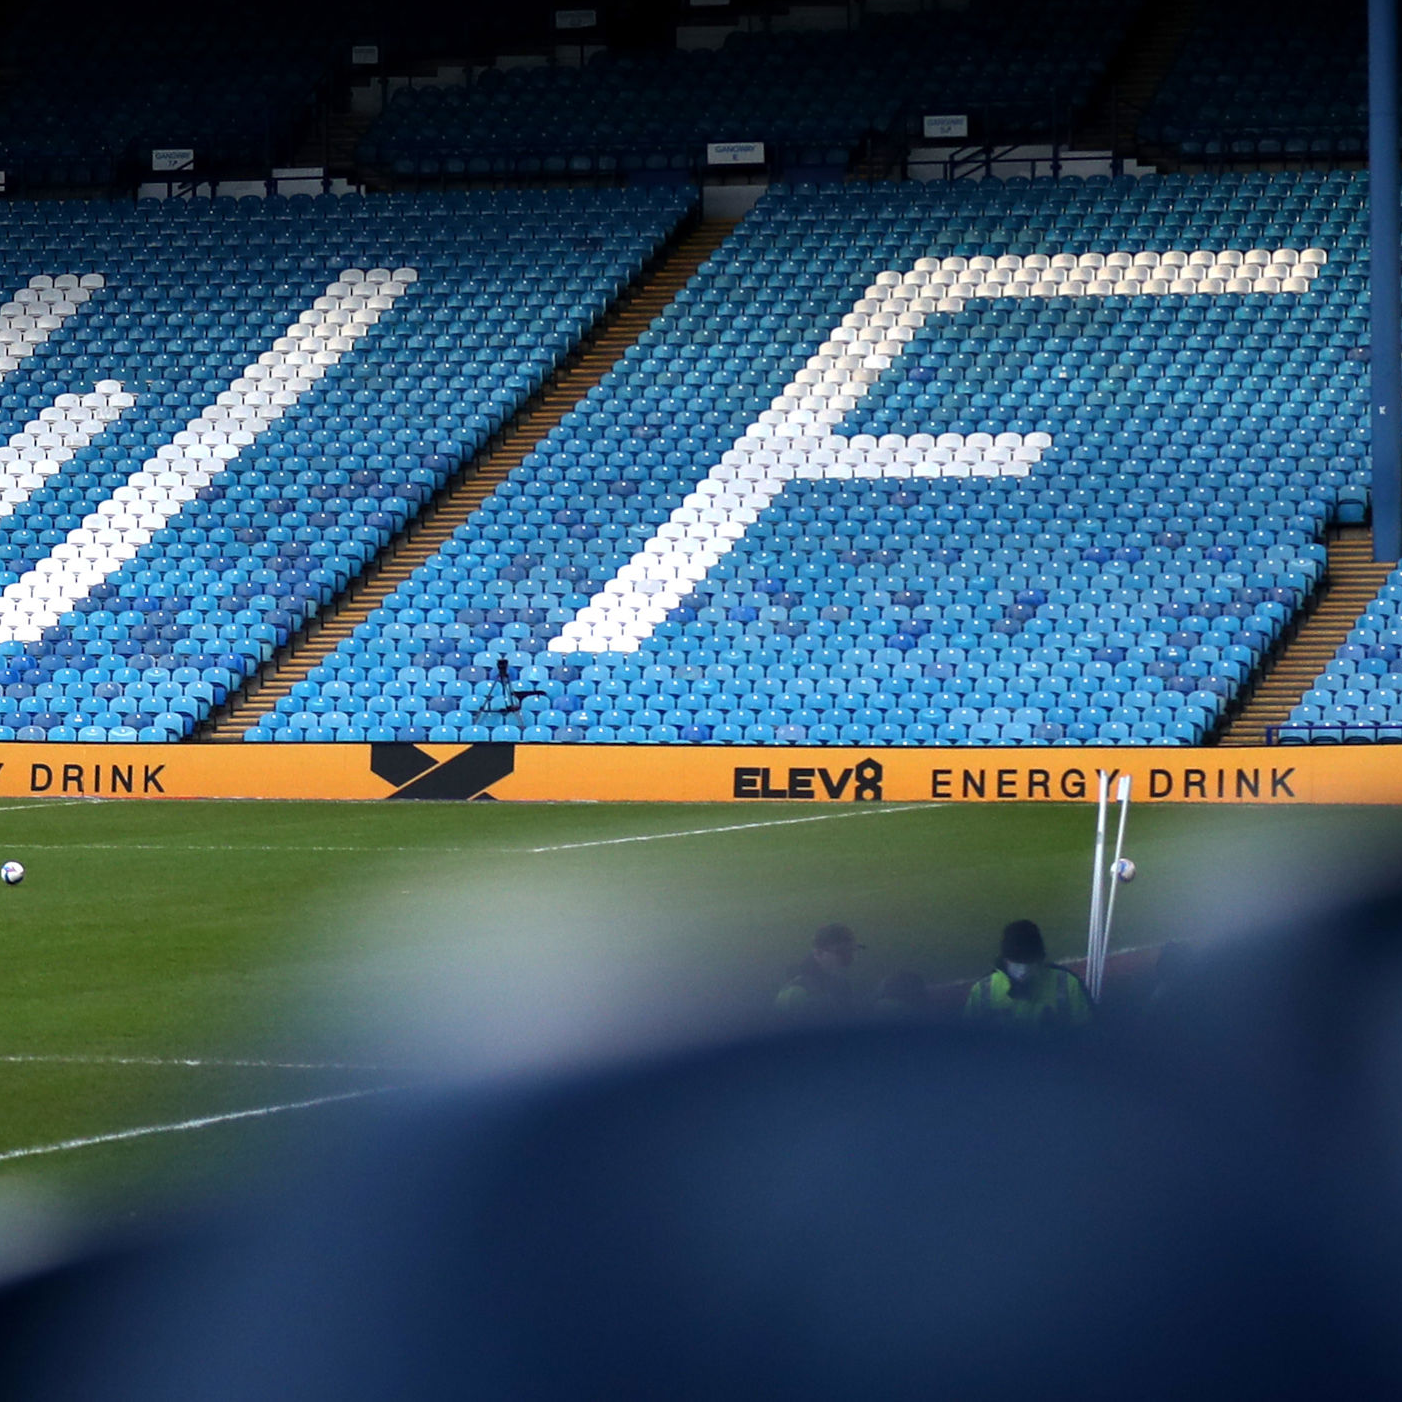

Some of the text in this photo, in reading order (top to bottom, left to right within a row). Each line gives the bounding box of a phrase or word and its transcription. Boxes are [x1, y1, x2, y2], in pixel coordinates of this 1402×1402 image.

[31, 763, 165, 793] DRINK
[733, 757, 1296, 801] ELEV8 ENERGY DRINK
